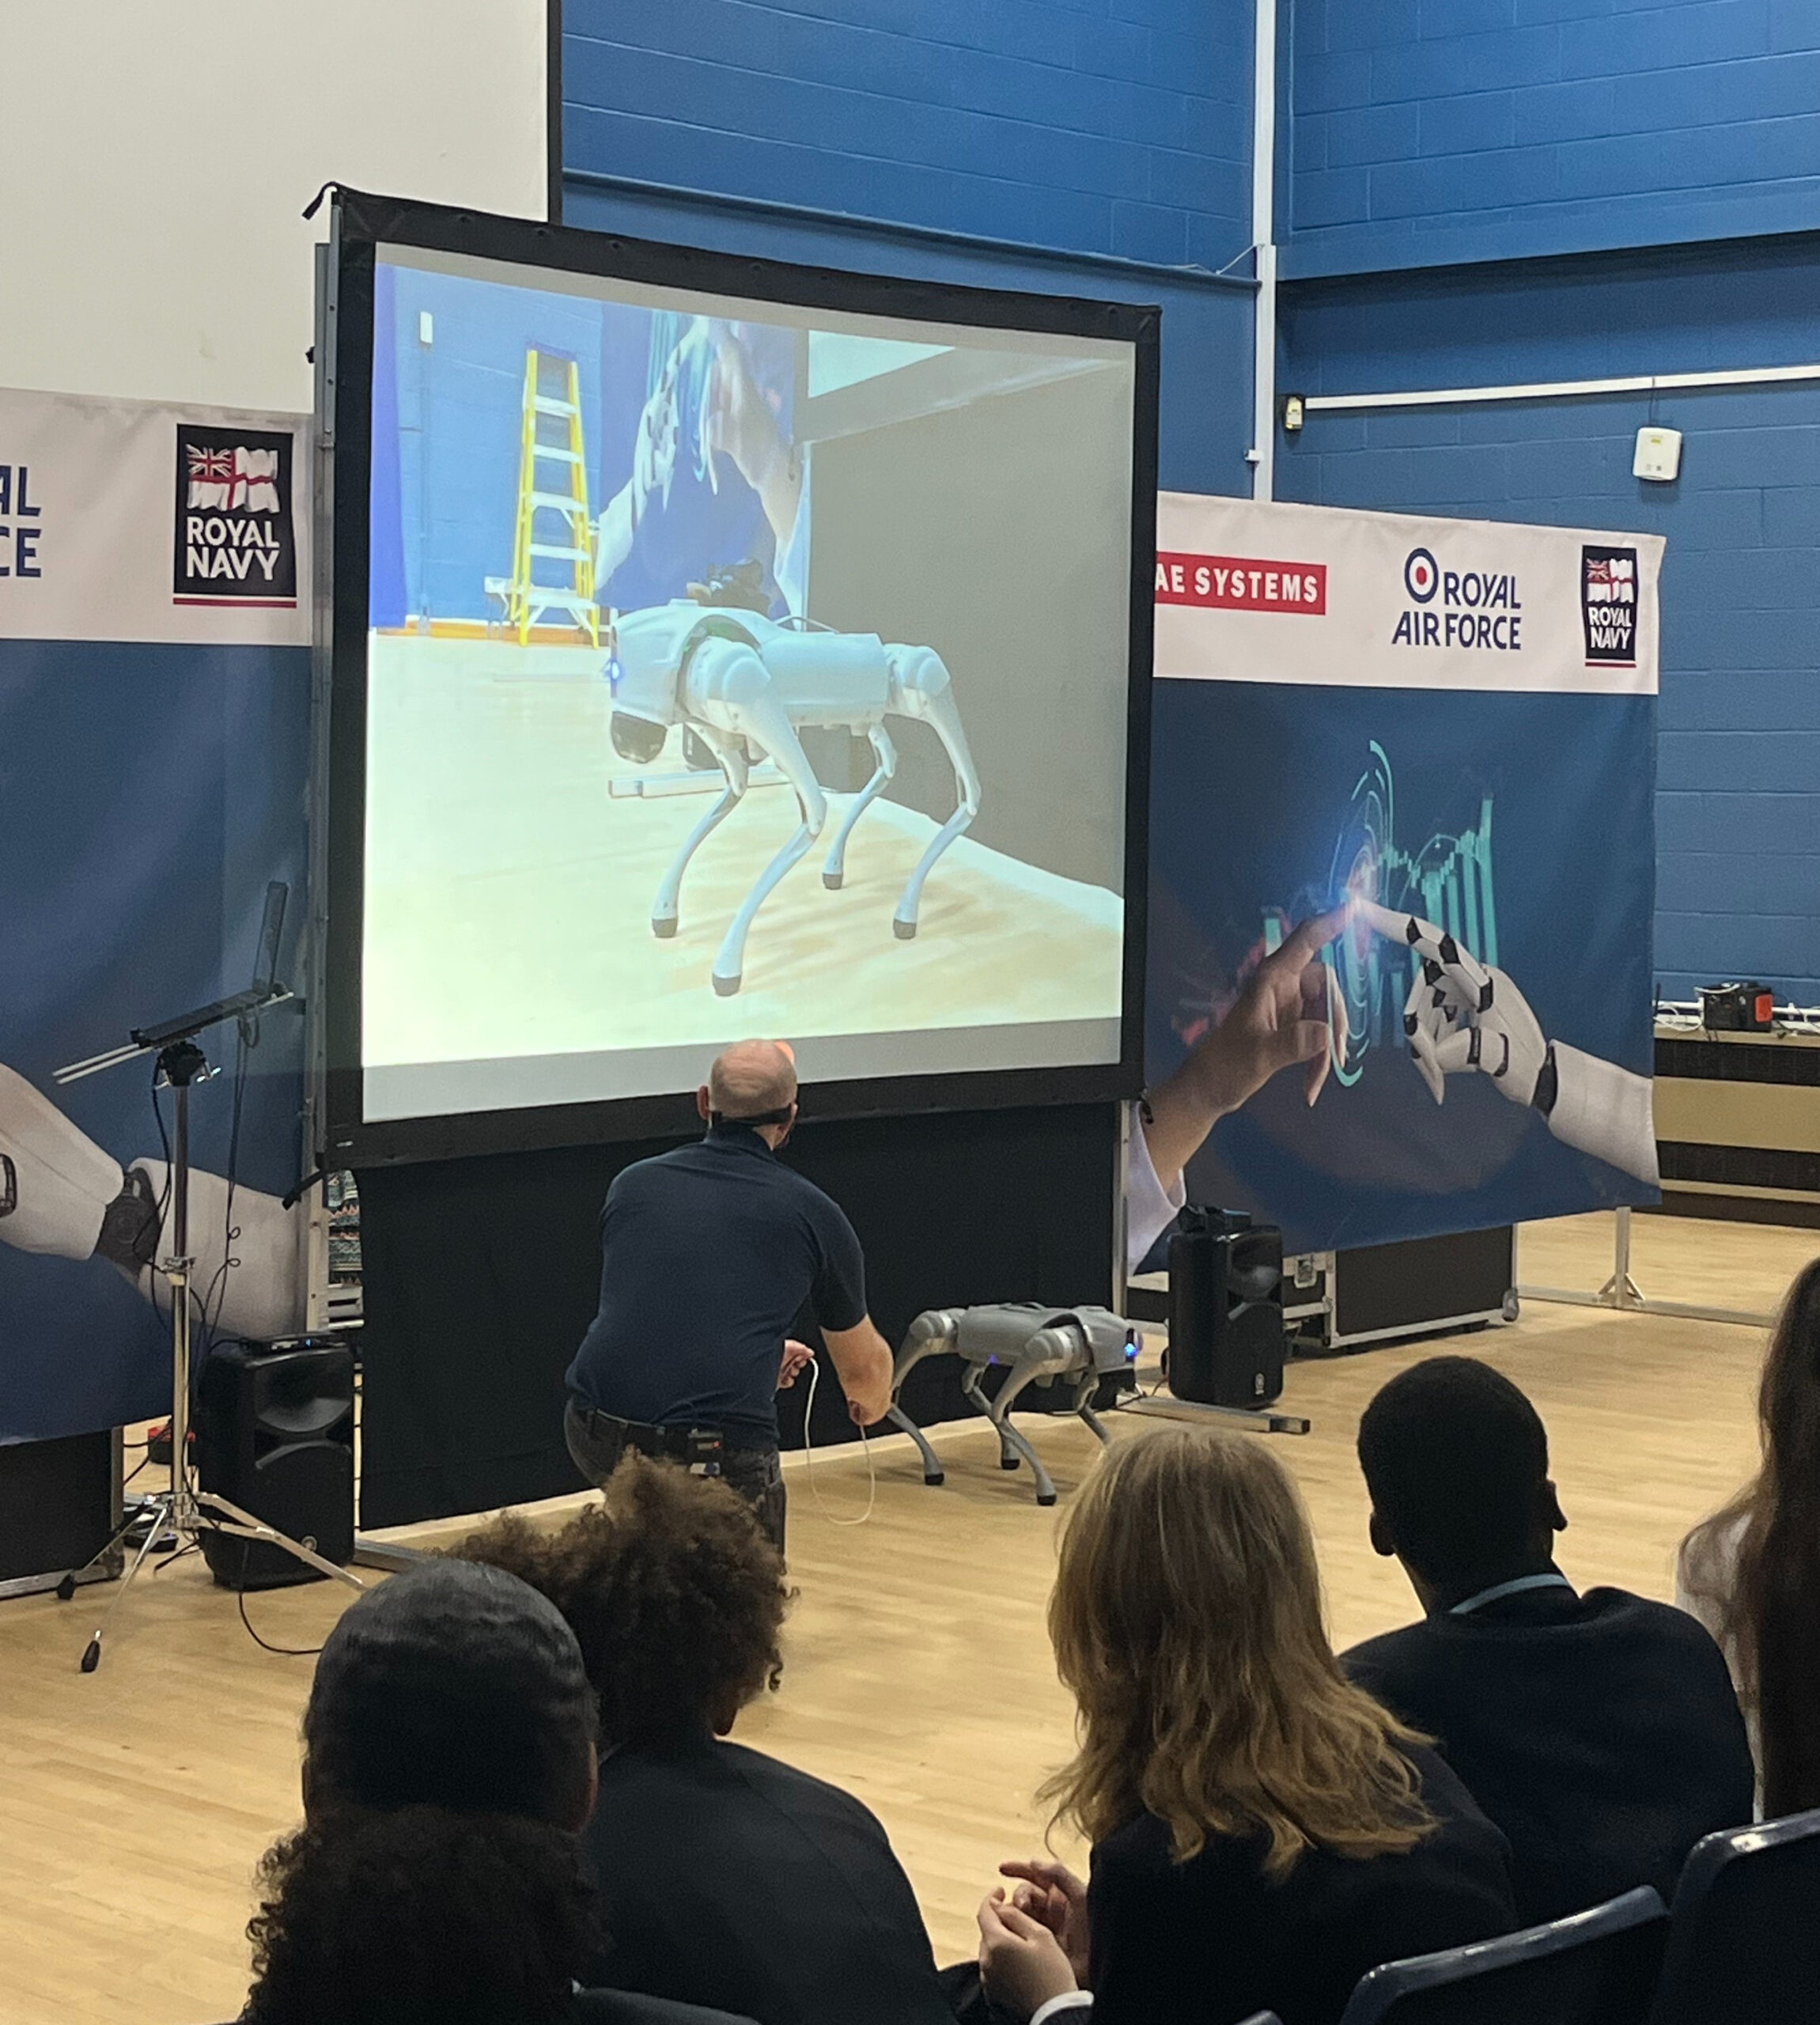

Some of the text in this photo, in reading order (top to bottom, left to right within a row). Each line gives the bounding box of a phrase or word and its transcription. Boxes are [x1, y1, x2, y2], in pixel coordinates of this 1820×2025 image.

[187, 517, 280, 547] ROYAL
[187, 546, 280, 581] NAVY
[1155, 562, 1319, 604] AE SYSTEMS
[1444, 571, 1522, 610] ROYAL
[1587, 606, 1633, 627] ROYAL
[1590, 626, 1632, 649] NAVY
